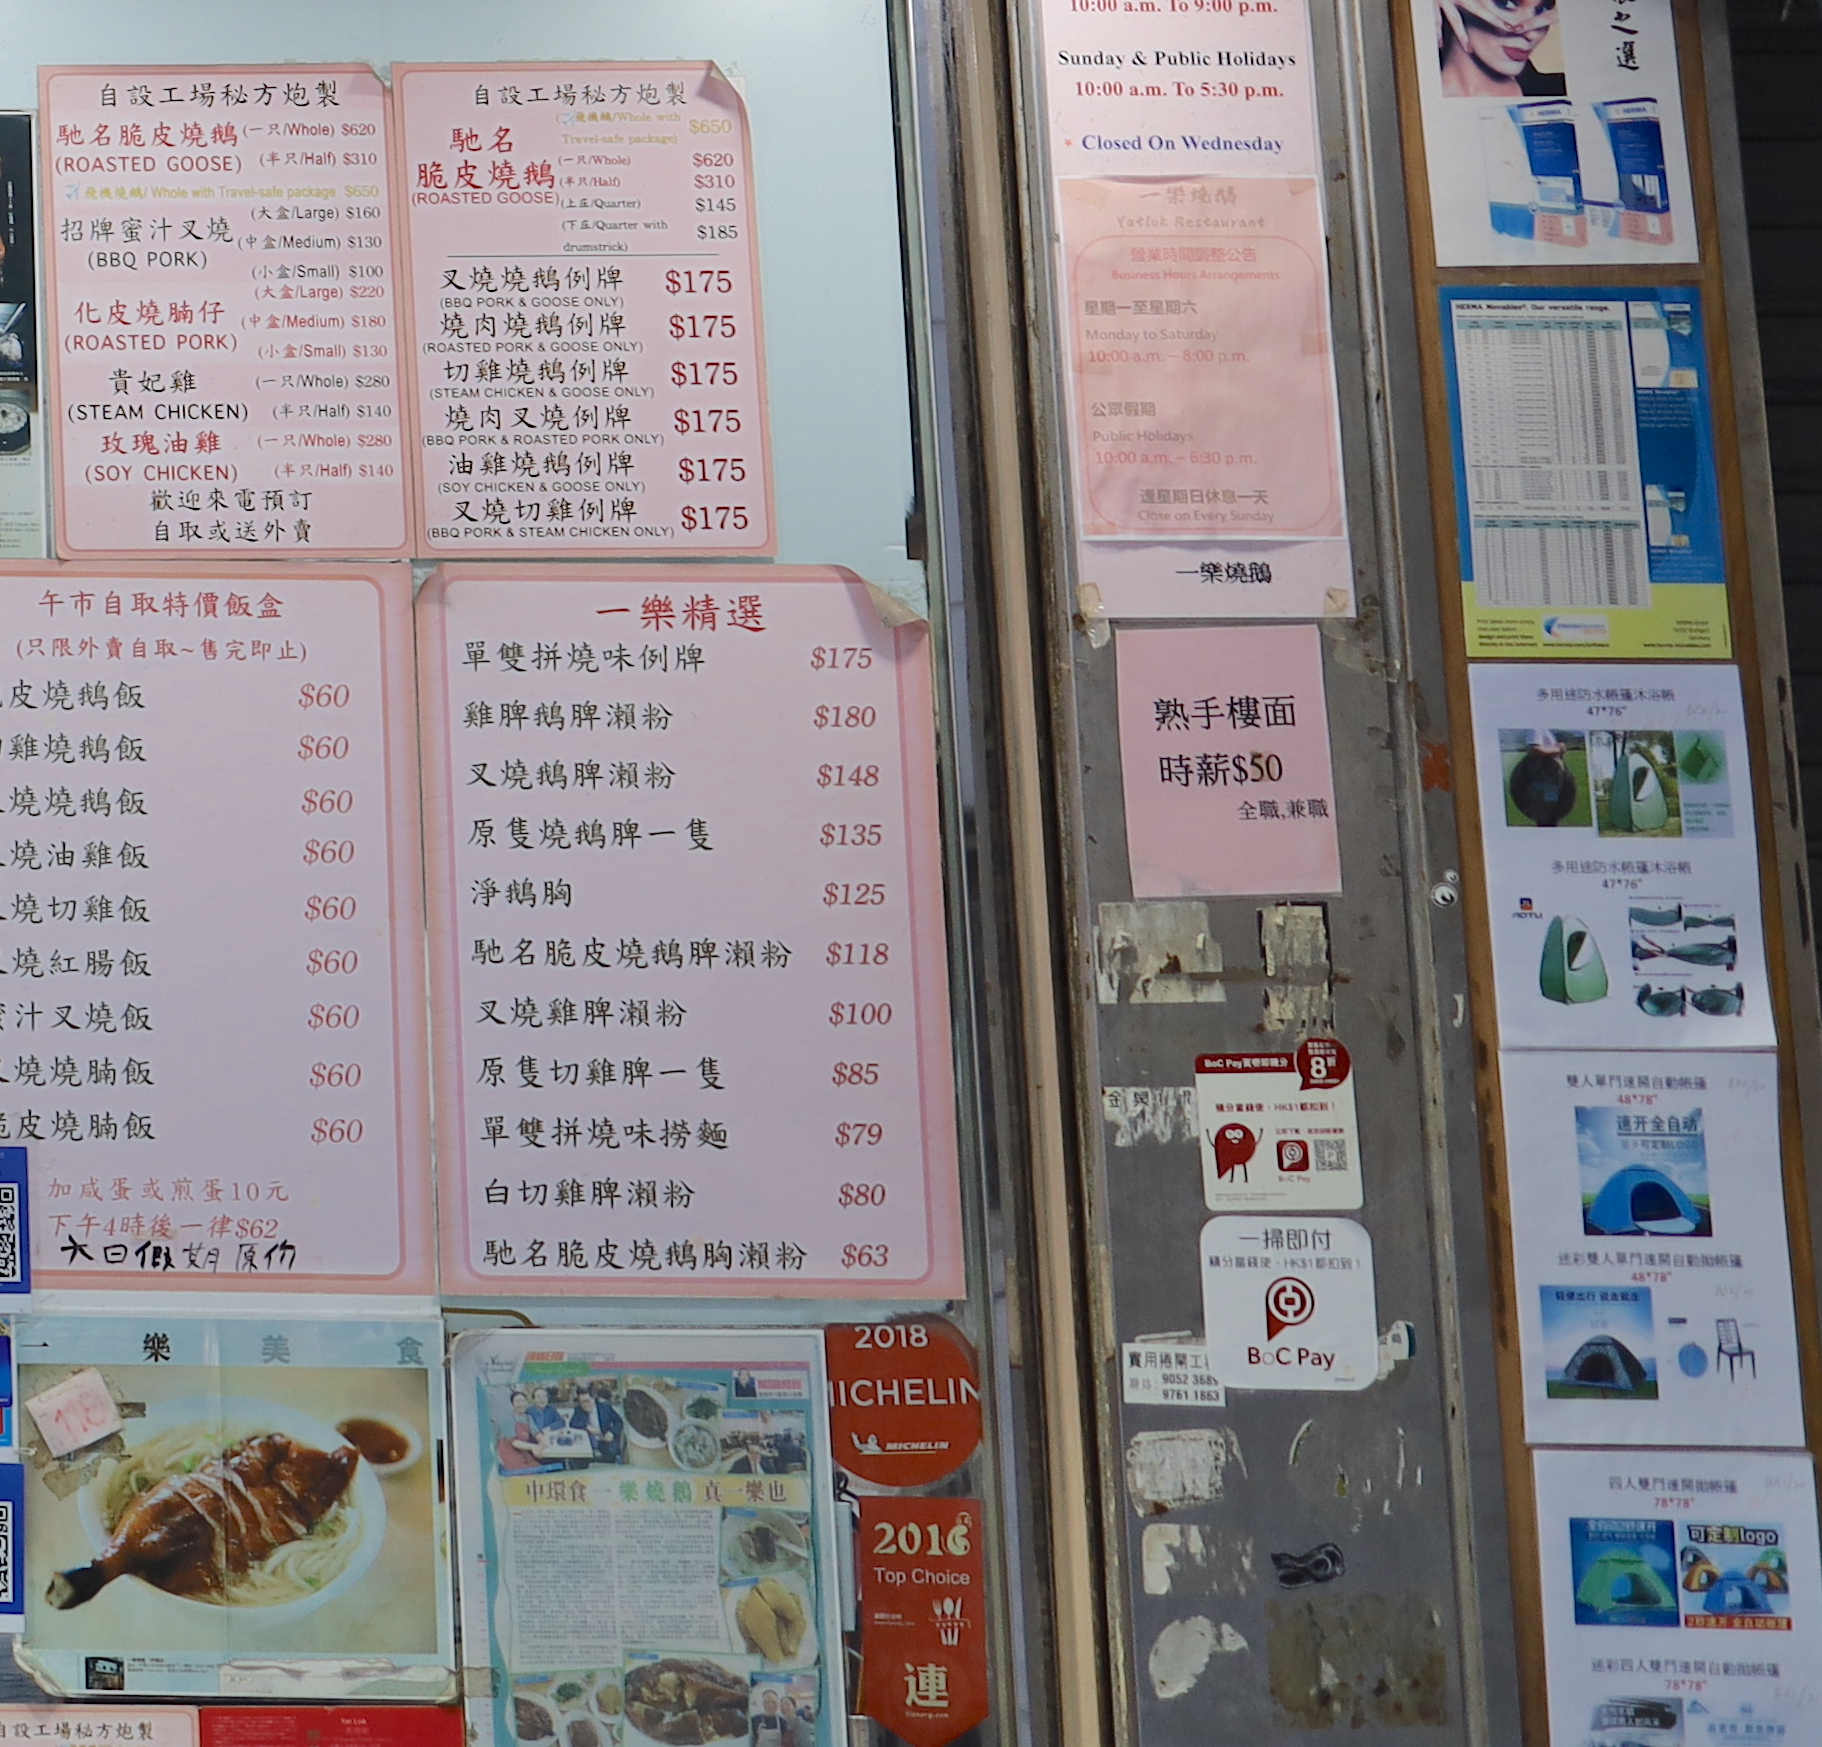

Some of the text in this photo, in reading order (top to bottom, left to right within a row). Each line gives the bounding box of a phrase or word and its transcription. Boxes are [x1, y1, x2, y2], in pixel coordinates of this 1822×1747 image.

[1058, 51, 1296, 69] Sunday Public Holidays
[100, 80, 340, 108] 自設工場秘方炮製
[1200, 82, 1239, 98] 5:30
[56, 122, 239, 148] 馳名脆皮燒鵝
[342, 122, 376, 137] $620
[449, 126, 514, 153] 馳名
[1081, 135, 1284, 154] Closed Wednesday
[55, 155, 243, 174] (ROASTED GOOSE)
[343, 152, 377, 166] $310
[416, 160, 555, 190] 脆皮燒鵝
[345, 185, 379, 198] $650
[346, 206, 380, 220] $160
[60, 217, 233, 245] 招牌蜜汁叉燒
[88, 251, 208, 270] (BBQ PORK)
[349, 264, 383, 278] $100
[440, 266, 733, 294] 叉燒燒鵝例牌 $175
[73, 300, 226, 327] 化皮燒腩仔
[440, 311, 626, 339] 燒肉燒鵝例牌
[108, 368, 197, 395] 貴妃雞
[445, 358, 629, 384] 切雞燒鵝例牌
[68, 403, 249, 422] (STEAM CHICKEN)
[100, 430, 221, 454] 玫瑰油雞
[85, 464, 239, 483] (SOY CHICKEN)
[151, 489, 313, 512] 歡迎來電預訂
[154, 520, 313, 544] 自取或送外賣
[38, 590, 284, 618] 午市自取特價飯盒
[596, 594, 767, 632] 一樂精選
[463, 641, 873, 674] 單雙拼燒味例牌 $175
[298, 683, 350, 709] $60
[463, 701, 673, 732] 雞脾鵝脾瀨粉
[1154, 695, 1296, 731] 熟手樓面
[466, 759, 677, 790] 叉燒鵝脾瀨粉
[1159, 754, 1283, 786] 時薪$50
[467, 818, 714, 851] 原隻燒鵝脾一隻
[470, 878, 572, 909] 淨鵝胸
[475, 997, 688, 1029] 叉燒雞脾瀨粉
[477, 1056, 726, 1090] 原隻切雞脾一隻
[485, 1177, 696, 1209] 白切雞脾瀨粉
[1239, 1228, 1332, 1251] 一掃即付
[854, 1325, 929, 1349] 2018
[1248, 1347, 1335, 1371] BoC Pay
[885, 1441, 950, 1450] MICHELIN
[873, 1521, 971, 1557] 2016
[874, 1567, 971, 1586] Top Choice
[904, 1663, 949, 1708] 連
